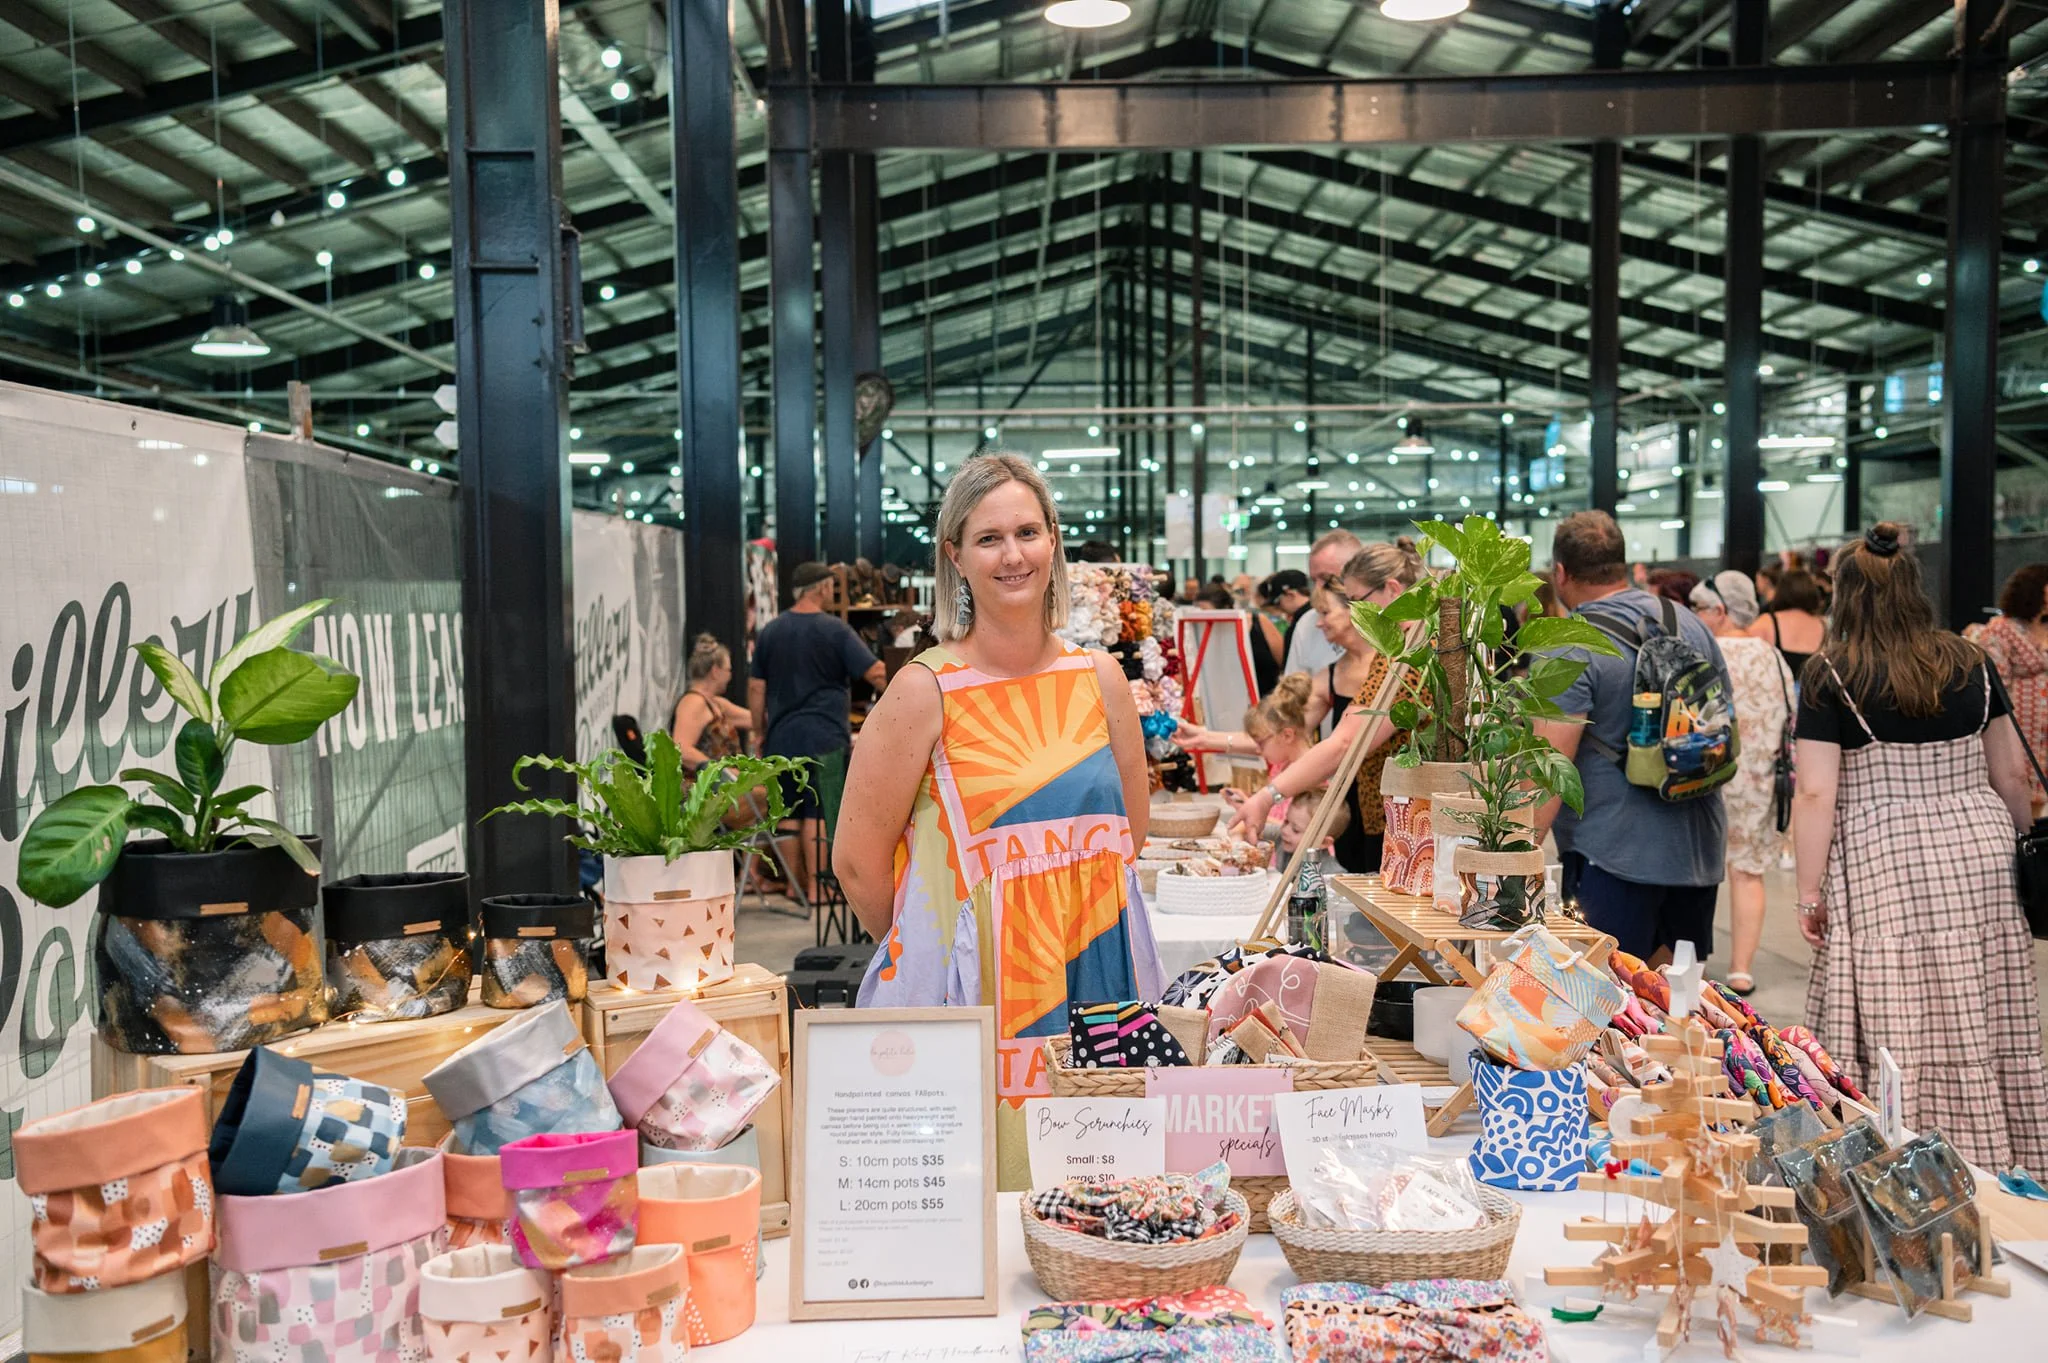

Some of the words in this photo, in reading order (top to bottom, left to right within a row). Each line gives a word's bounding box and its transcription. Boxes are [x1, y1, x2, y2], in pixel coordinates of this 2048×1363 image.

[313, 612, 398, 757] NOW
[885, 1090, 911, 1098] canvas
[1304, 1095, 1337, 1128] Face
[1340, 1094, 1394, 1127] Masks
[1038, 1107, 1069, 1141] Bow
[1074, 1106, 1152, 1140] Scrunchies
[1220, 1126, 1276, 1162] specials
[839, 1155, 852, 1167] S:
[857, 1156, 889, 1167] 10cm
[892, 1156, 919, 1168] pots
[922, 1154, 945, 1166] $35
[1066, 1155, 1095, 1165] Small
[1101, 1154, 1115, 1165] $8
[838, 1178, 853, 1189] M:
[858, 1177, 890, 1189] 14cm
[893, 1178, 919, 1190] pots
[923, 1176, 946, 1188] $45
[839, 1200, 851, 1212] L:
[854, 1200, 888, 1211] 20cm
[892, 1199, 918, 1213] pots
[921, 1197, 944, 1210] $55
